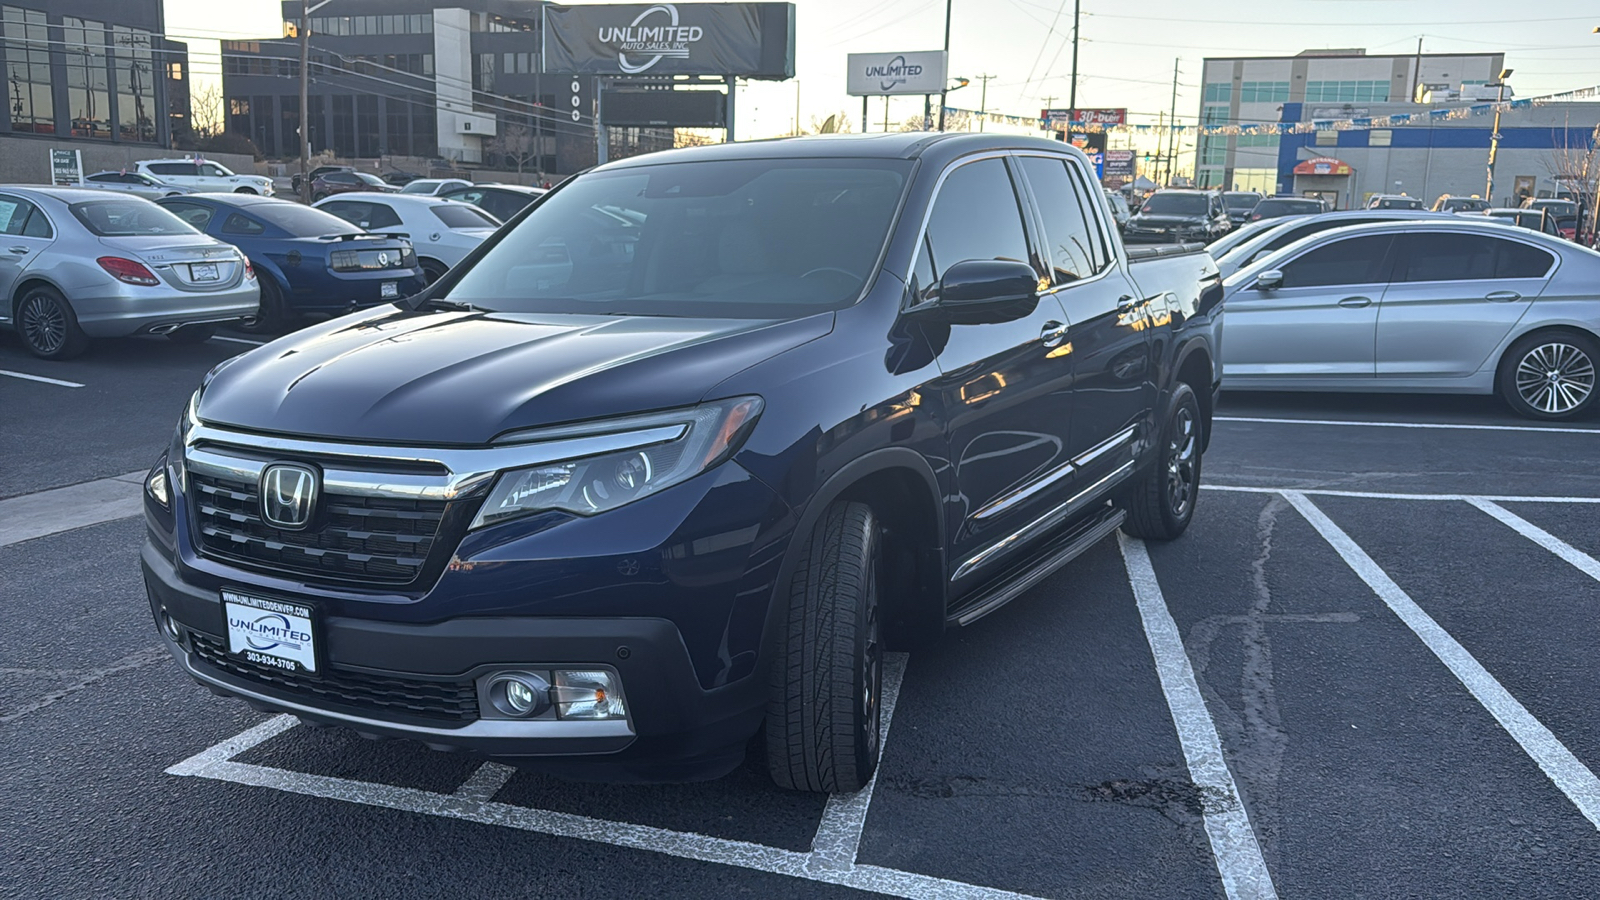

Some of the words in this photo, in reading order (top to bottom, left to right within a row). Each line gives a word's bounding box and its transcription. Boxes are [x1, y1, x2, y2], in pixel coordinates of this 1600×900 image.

[598, 26, 703, 43] UNLIMITED
[620, 42, 644, 50] AUTO
[865, 65, 922, 77] UNLIMITED
[1308, 157, 1338, 165] ENTRANCE
[230, 618, 311, 641] UNLIMITED
[246, 651, 296, 671] 303-934-3705
